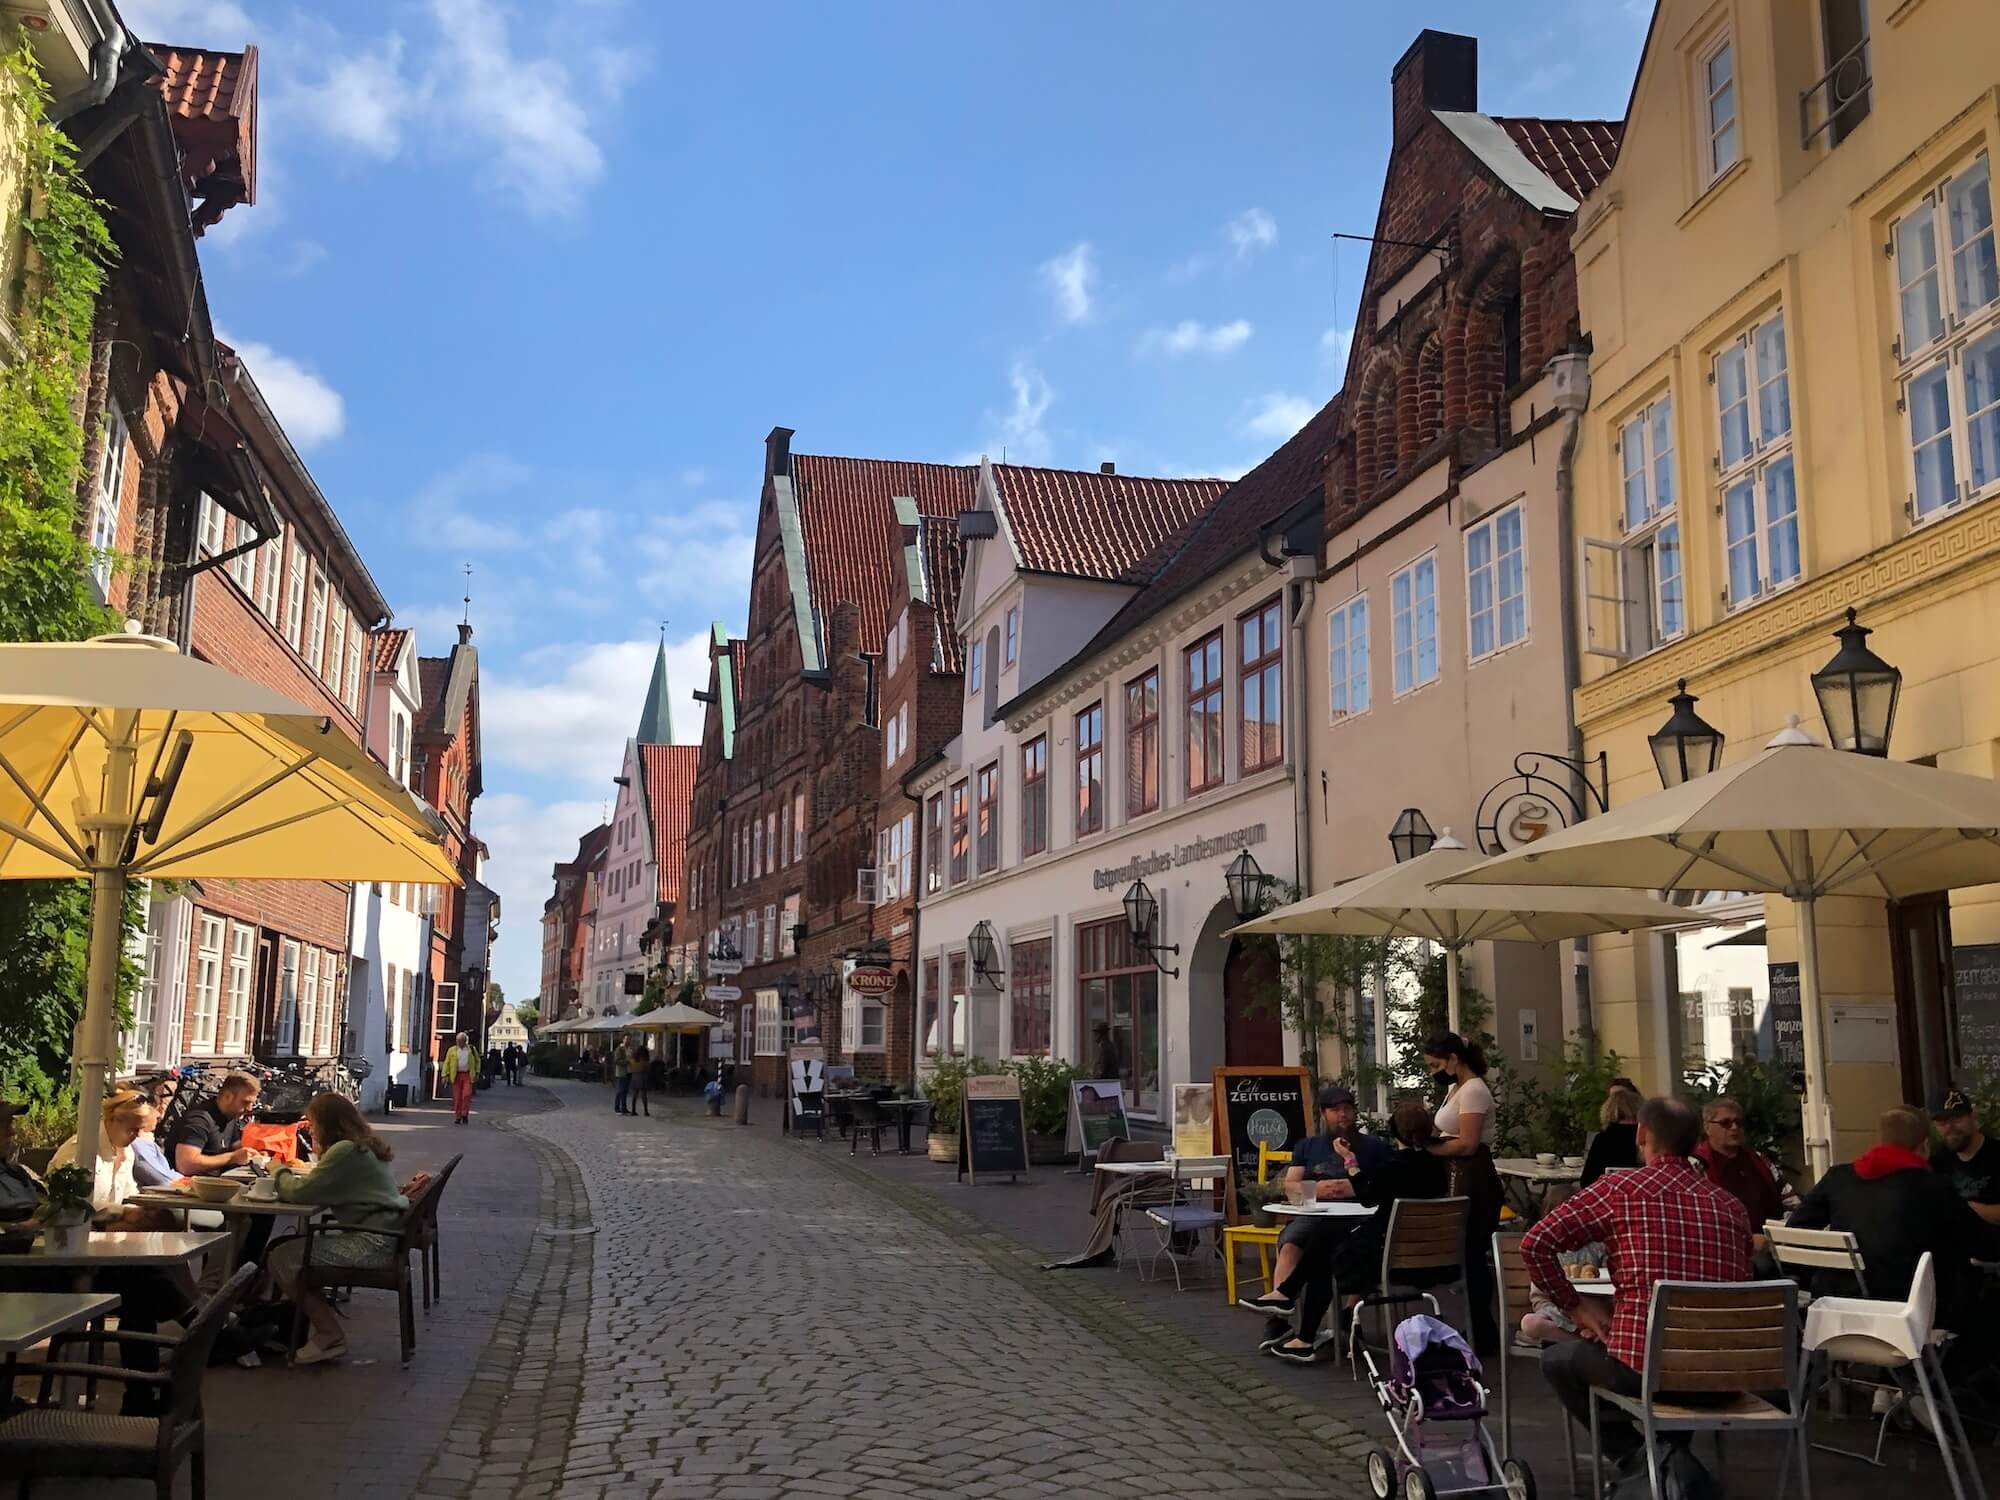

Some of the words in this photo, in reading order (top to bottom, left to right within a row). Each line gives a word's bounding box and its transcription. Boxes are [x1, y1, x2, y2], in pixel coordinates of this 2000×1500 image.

[850, 975, 895, 987] KRONE
[1686, 998, 1763, 1019] ZEITGEIST
[1230, 1092, 1298, 1102] ZEITGEIST
